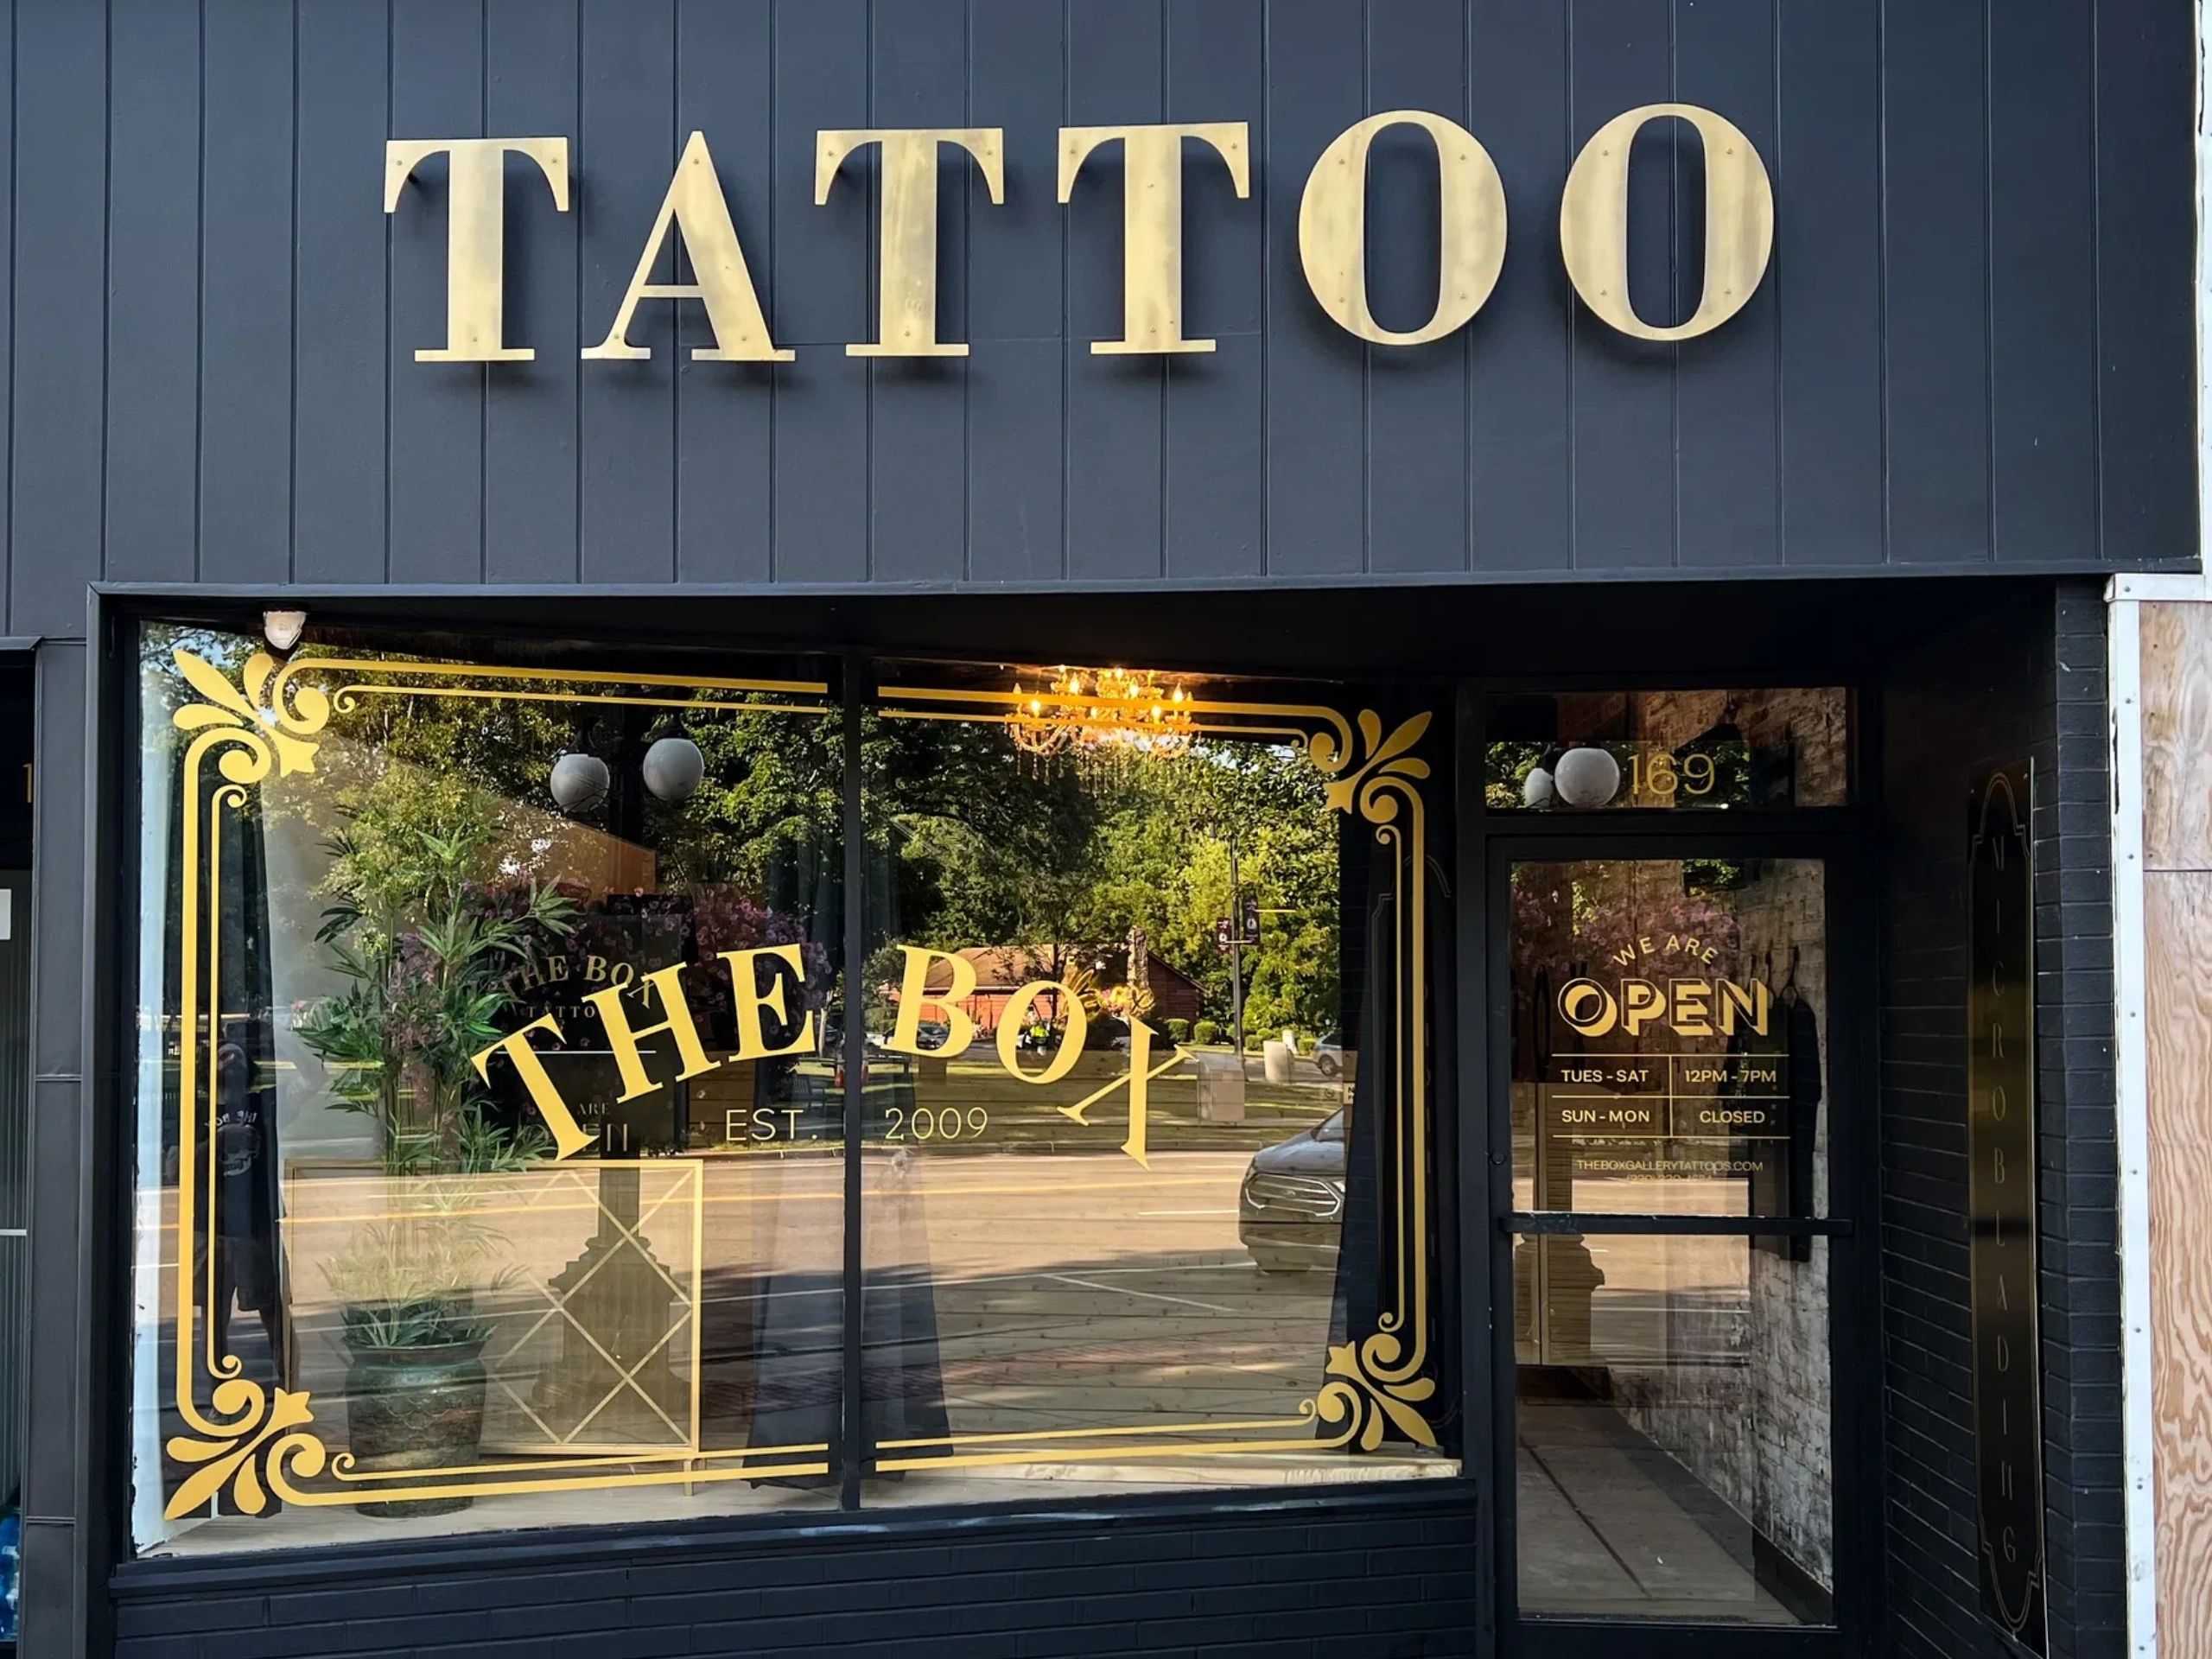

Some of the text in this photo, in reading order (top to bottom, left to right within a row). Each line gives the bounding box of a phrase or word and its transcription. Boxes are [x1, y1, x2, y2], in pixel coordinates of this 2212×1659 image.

[384, 102, 1775, 365] TATTOO
[1628, 753, 1715, 795] 169
[1613, 935, 1719, 967] WE ARE
[1558, 977, 1769, 1037] OPEN
[472, 943, 1196, 1172] THE BOX
[1561, 1070, 1603, 1083] TUES
[1617, 1070, 1649, 1083] SAT
[1685, 1070, 1727, 1083] 12PM
[1741, 1071, 1777, 1083] 7PM
[726, 1107, 989, 1141] EST. 2009
[1561, 1109, 1596, 1123] SUN
[1609, 1109, 1650, 1123] MON
[1700, 1110, 1765, 1124] CLOSED
[1577, 1160, 1764, 1172] THEBOXGALLERYTATTOOS.COM
[1991, 835, 2017, 1564] MICROBLADING
